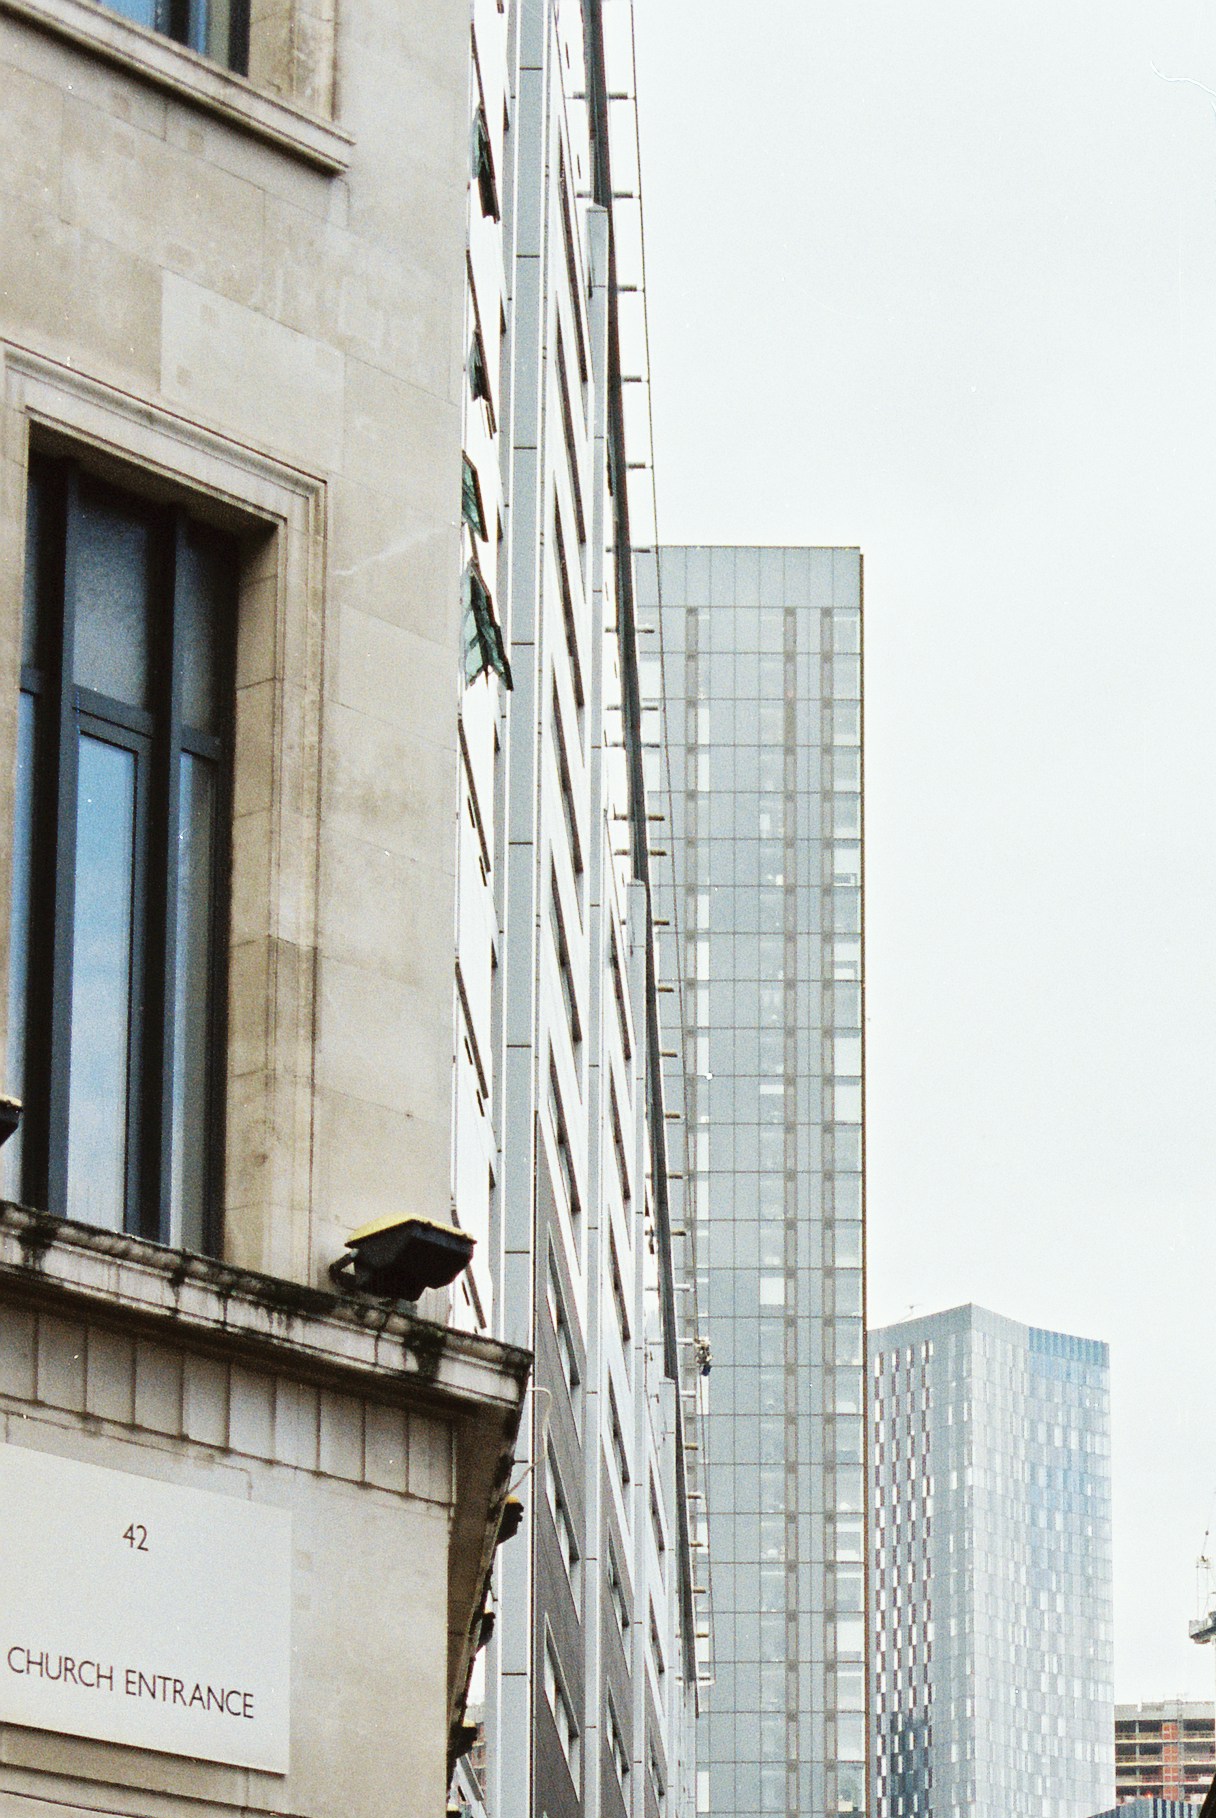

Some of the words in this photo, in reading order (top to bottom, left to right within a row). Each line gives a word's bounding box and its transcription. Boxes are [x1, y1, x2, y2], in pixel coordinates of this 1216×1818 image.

[121, 1522, 150, 1552] 42
[6, 1645, 115, 1692] CHURCH
[124, 1668, 255, 1719] ENTRANCE
